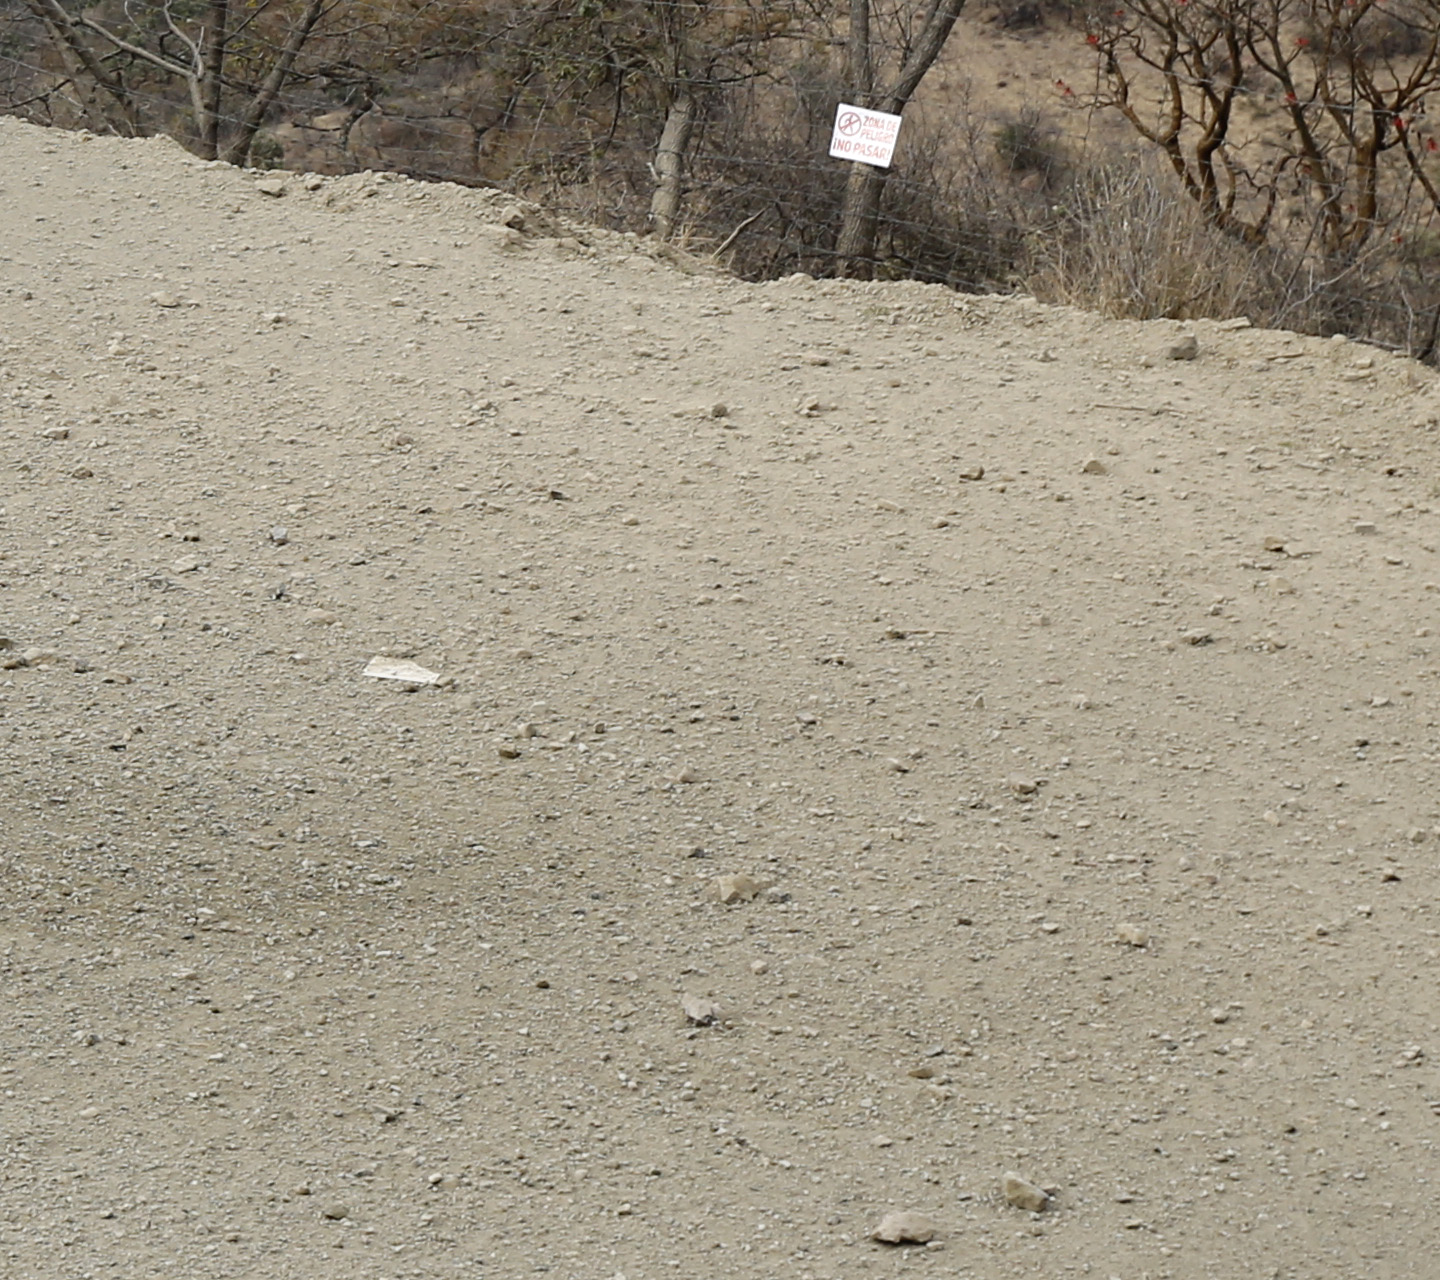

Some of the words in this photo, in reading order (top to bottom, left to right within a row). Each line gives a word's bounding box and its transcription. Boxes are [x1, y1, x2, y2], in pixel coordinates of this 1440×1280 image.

[863, 115, 884, 129] ZONA
[886, 120, 897, 132] DE
[860, 128, 894, 144] PELIGRO
[853, 142, 891, 160] PASAR!
